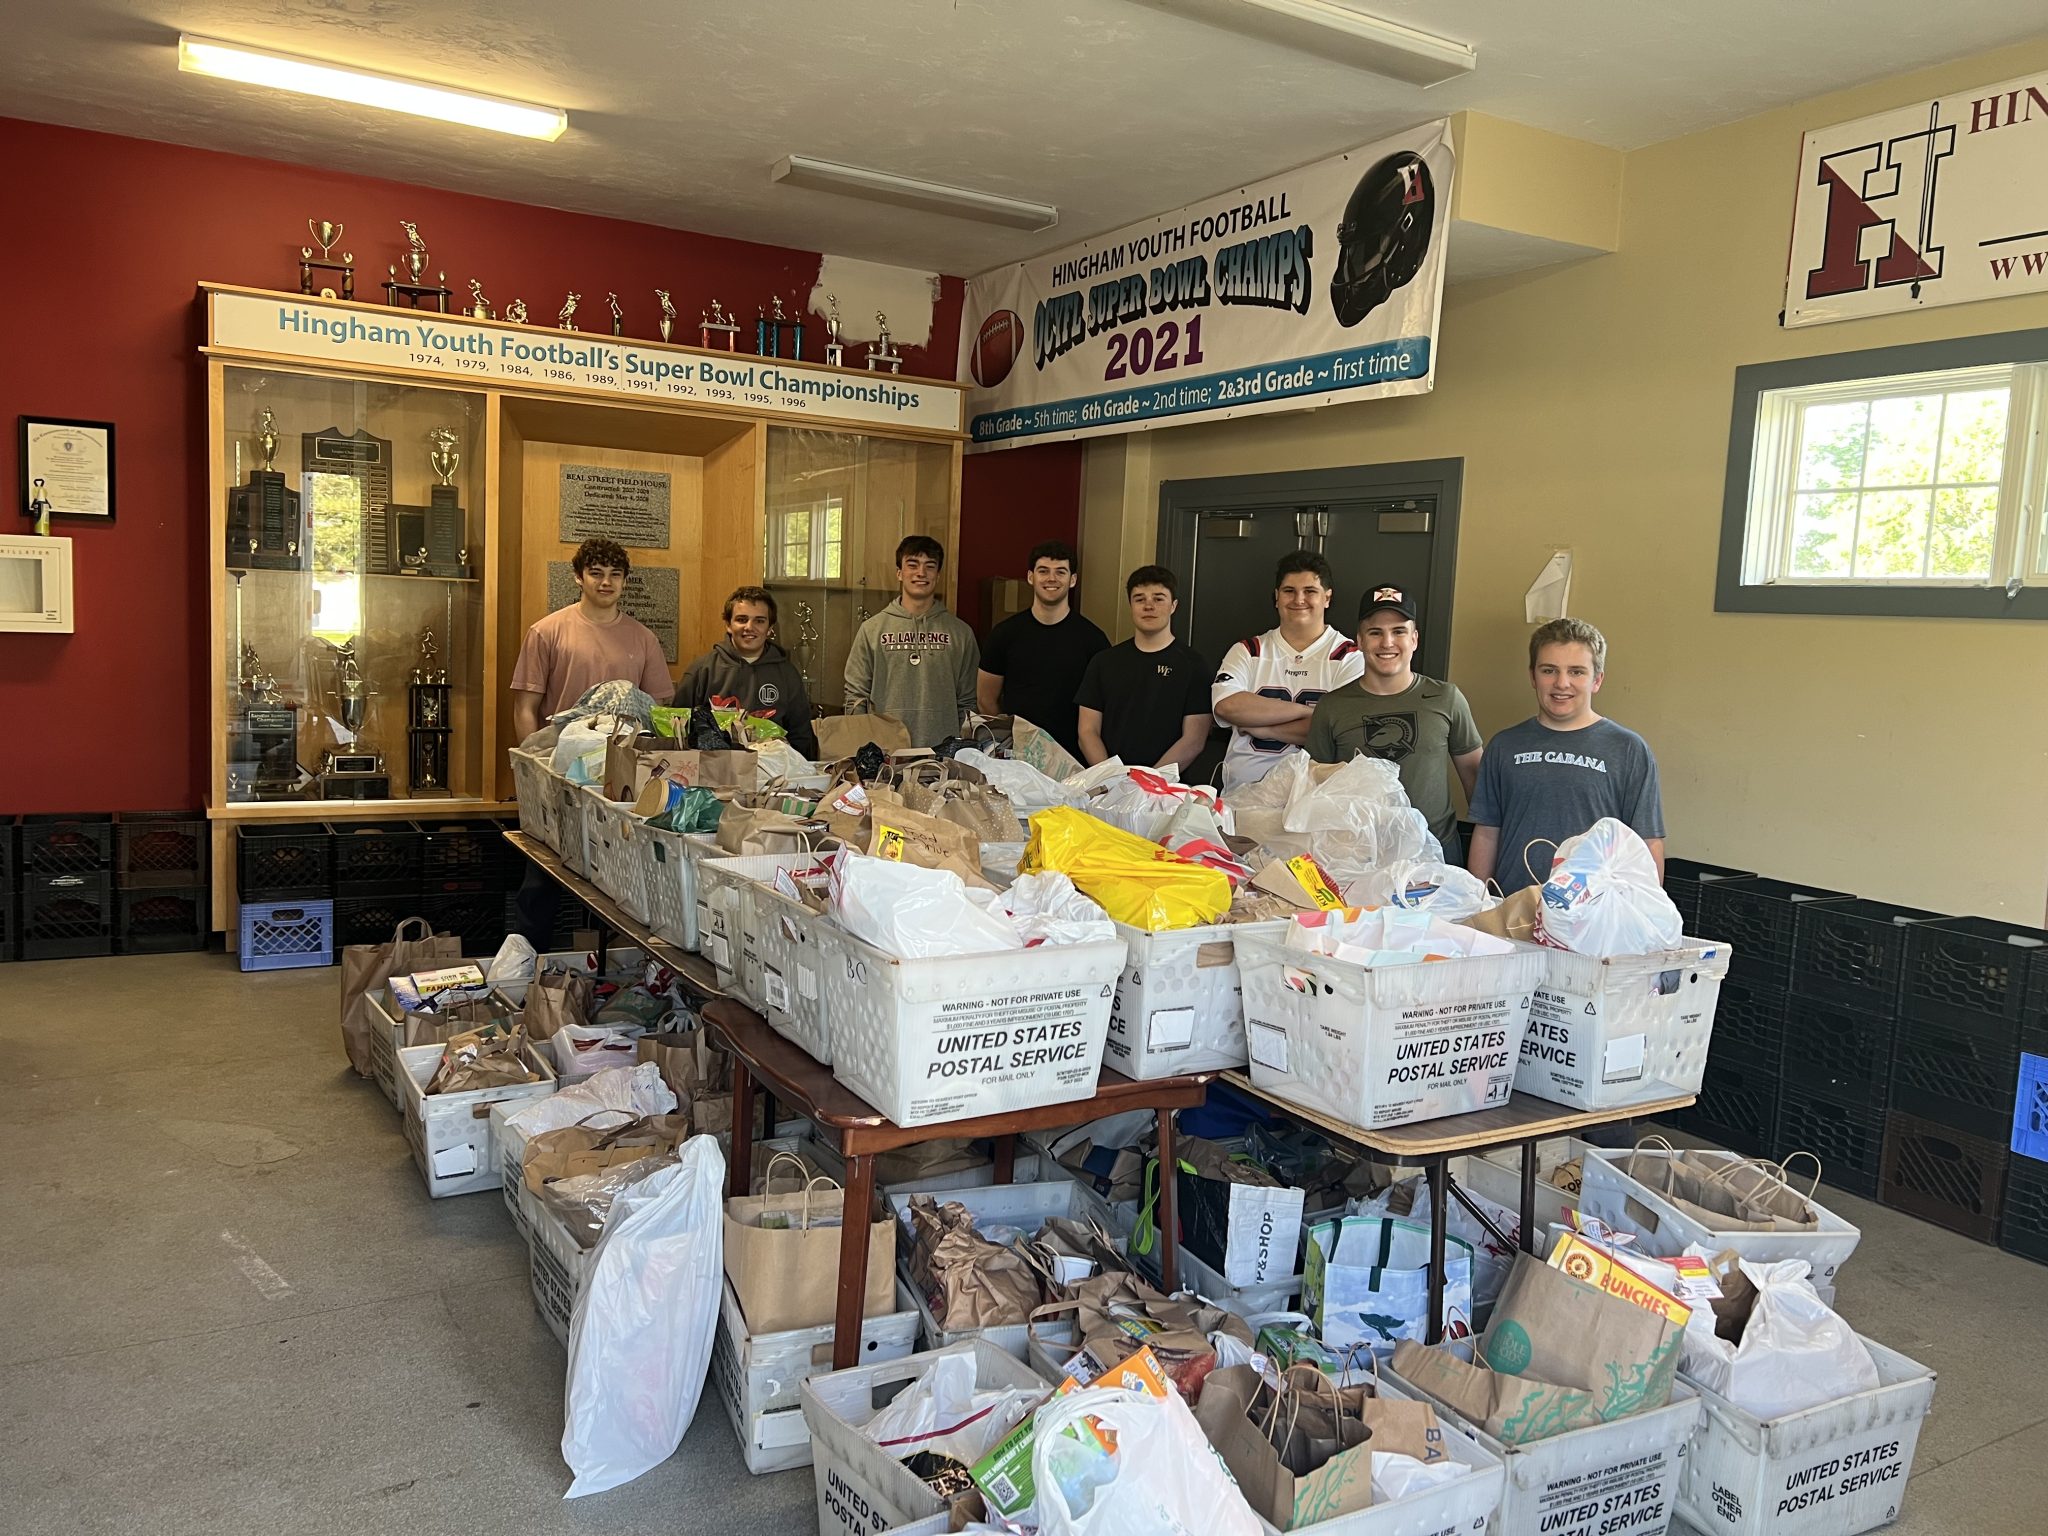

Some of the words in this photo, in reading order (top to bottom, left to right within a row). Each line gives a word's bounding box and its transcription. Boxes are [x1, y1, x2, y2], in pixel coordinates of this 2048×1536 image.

[1052, 245, 1124, 287] HINGHAM
[1128, 225, 1186, 262] YOUTH
[1190, 192, 1291, 247] FOOTBALL
[1088, 275, 1146, 338] SUPER
[1149, 255, 1210, 316] BOWL
[1214, 225, 1313, 316] CHAMPS
[279, 308, 410, 345] Hingham
[416, 326, 493, 355] Youth
[501, 337, 620, 371] Football's
[625, 354, 694, 381] Super
[699, 363, 754, 388] Bowl
[760, 370, 920, 410] Championships
[1104, 314, 1203, 381] 2021
[409, 353, 445, 367] 1974,
[456, 358, 490, 372] 1979,
[500, 364, 533, 377] 1984,
[544, 369, 576, 382] 1986,
[586, 373, 618, 387] 1989,
[627, 379, 658, 391] 1991,
[667, 383, 697, 396] 1992,
[706, 388, 736, 400] 1993,
[744, 392, 772, 405] 1995,
[781, 397, 806, 408] 1996
[979, 416, 994, 436] 8th
[995, 414, 1023, 433] Grade
[1033, 410, 1049, 428] 5th
[1051, 408, 1077, 426] time;
[1081, 401, 1101, 421] 6th
[1103, 397, 1139, 418] Grade
[1152, 390, 1176, 411] 2nd
[1178, 386, 1212, 408] time;
[1217, 377, 1261, 401] 2&3rd
[1264, 370, 1313, 395] Grade
[1333, 357, 1365, 382] first
[1368, 350, 1410, 376] time
[587, 475, 617, 484] STREET
[640, 479, 667, 488] HOUSE
[881, 632, 896, 644] ST.
[1514, 751, 1542, 765] THE
[1544, 751, 1607, 774] CABANA
[942, 1000, 984, 1012] WARNING
[991, 997, 1009, 1007] NOT
[1010, 996, 1028, 1004] FOR
[1030, 991, 1063, 1002] PRIVATE
[1065, 989, 1081, 998] USE
[1402, 1008, 1434, 1019] WARNING
[1439, 1006, 1452, 1015] NOT
[1454, 1004, 1467, 1013] FOR
[1468, 1001, 1493, 1011] PRIVATE
[1494, 1000, 1507, 1008] USE
[1551, 994, 1566, 1004] USE
[937, 1031, 1008, 1055] UNITED
[1013, 1021, 1082, 1045] STATES
[1396, 1039, 1450, 1061] UNITED
[1453, 1031, 1506, 1053] STATES
[1528, 1020, 1569, 1044] ATES
[927, 1055, 1004, 1080] POSTAL
[1010, 1042, 1087, 1068] SERVICE
[1387, 1061, 1445, 1085] POSTAL
[1450, 1052, 1509, 1075] SERVICE
[1520, 1039, 1576, 1068] ERVICE
[981, 1076, 997, 1085] FOR
[998, 1073, 1015, 1083] MAIL
[1016, 1070, 1036, 1081] ONLY
[1453, 1079, 1468, 1087] ONLY
[550, 1276, 572, 1314] STATES
[1600, 1272, 1672, 1317] BUNCHES
[1547, 1476, 1582, 1492] WARNING
[1587, 1470, 1602, 1480] NOT
[1603, 1466, 1619, 1476] FOR
[1619, 1457, 1648, 1472] PRIVATE
[1649, 1453, 1662, 1463] USE
[1786, 1459, 1840, 1491] UNITED
[1842, 1441, 1899, 1471] STATES
[827, 1468, 869, 1519] UNITED
[1711, 1492, 1742, 1518] OTHER
[1712, 1481, 1742, 1508] LABEL
[1776, 1484, 1835, 1517] POSTAL
[1839, 1462, 1902, 1496] SERVICE
[1540, 1502, 1599, 1532] UNITED
[1602, 1483, 1661, 1514] STATES
[1599, 1503, 1664, 1536] SERVICE
[1717, 1505, 1736, 1523] END
